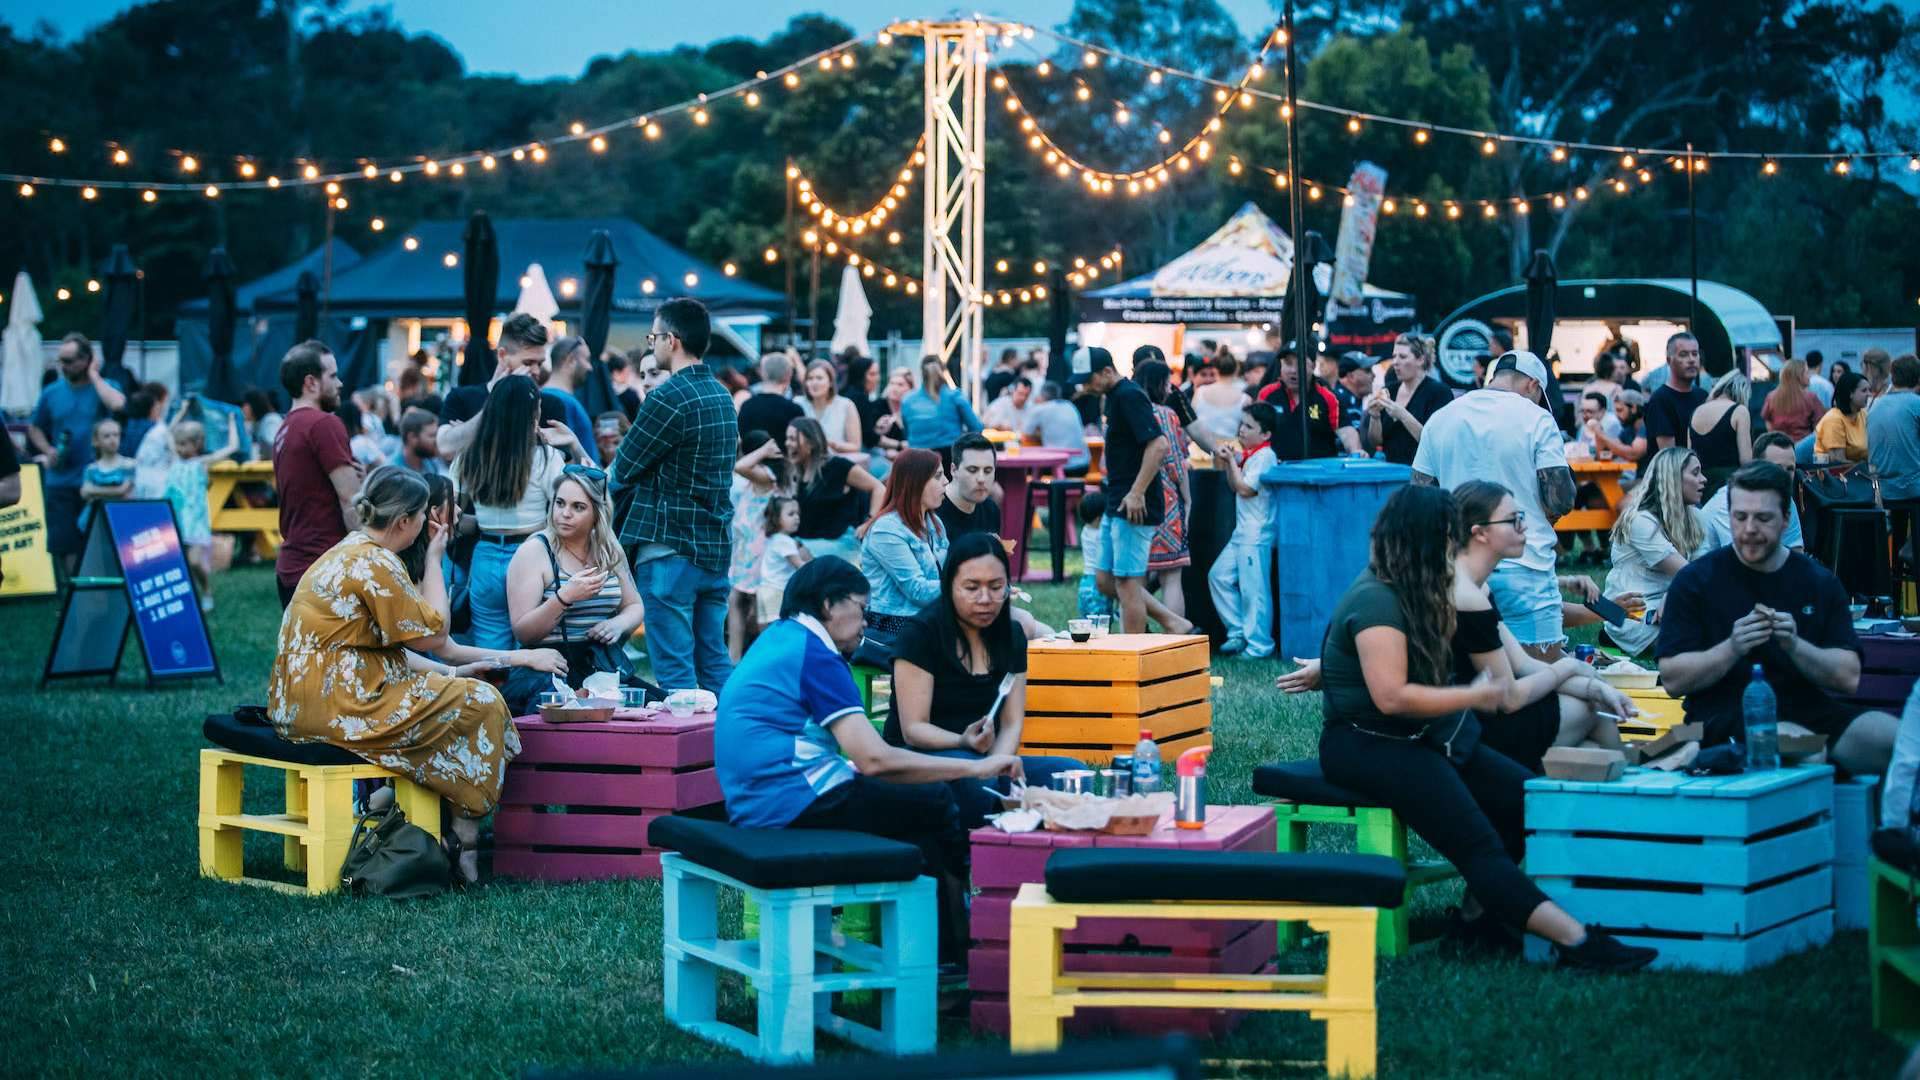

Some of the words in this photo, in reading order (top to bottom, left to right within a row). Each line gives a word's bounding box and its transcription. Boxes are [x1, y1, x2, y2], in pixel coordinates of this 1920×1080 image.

[1153, 298, 1211, 311] Community
[1122, 310, 1174, 322] Corporate
[1175, 310, 1228, 321] Functions
